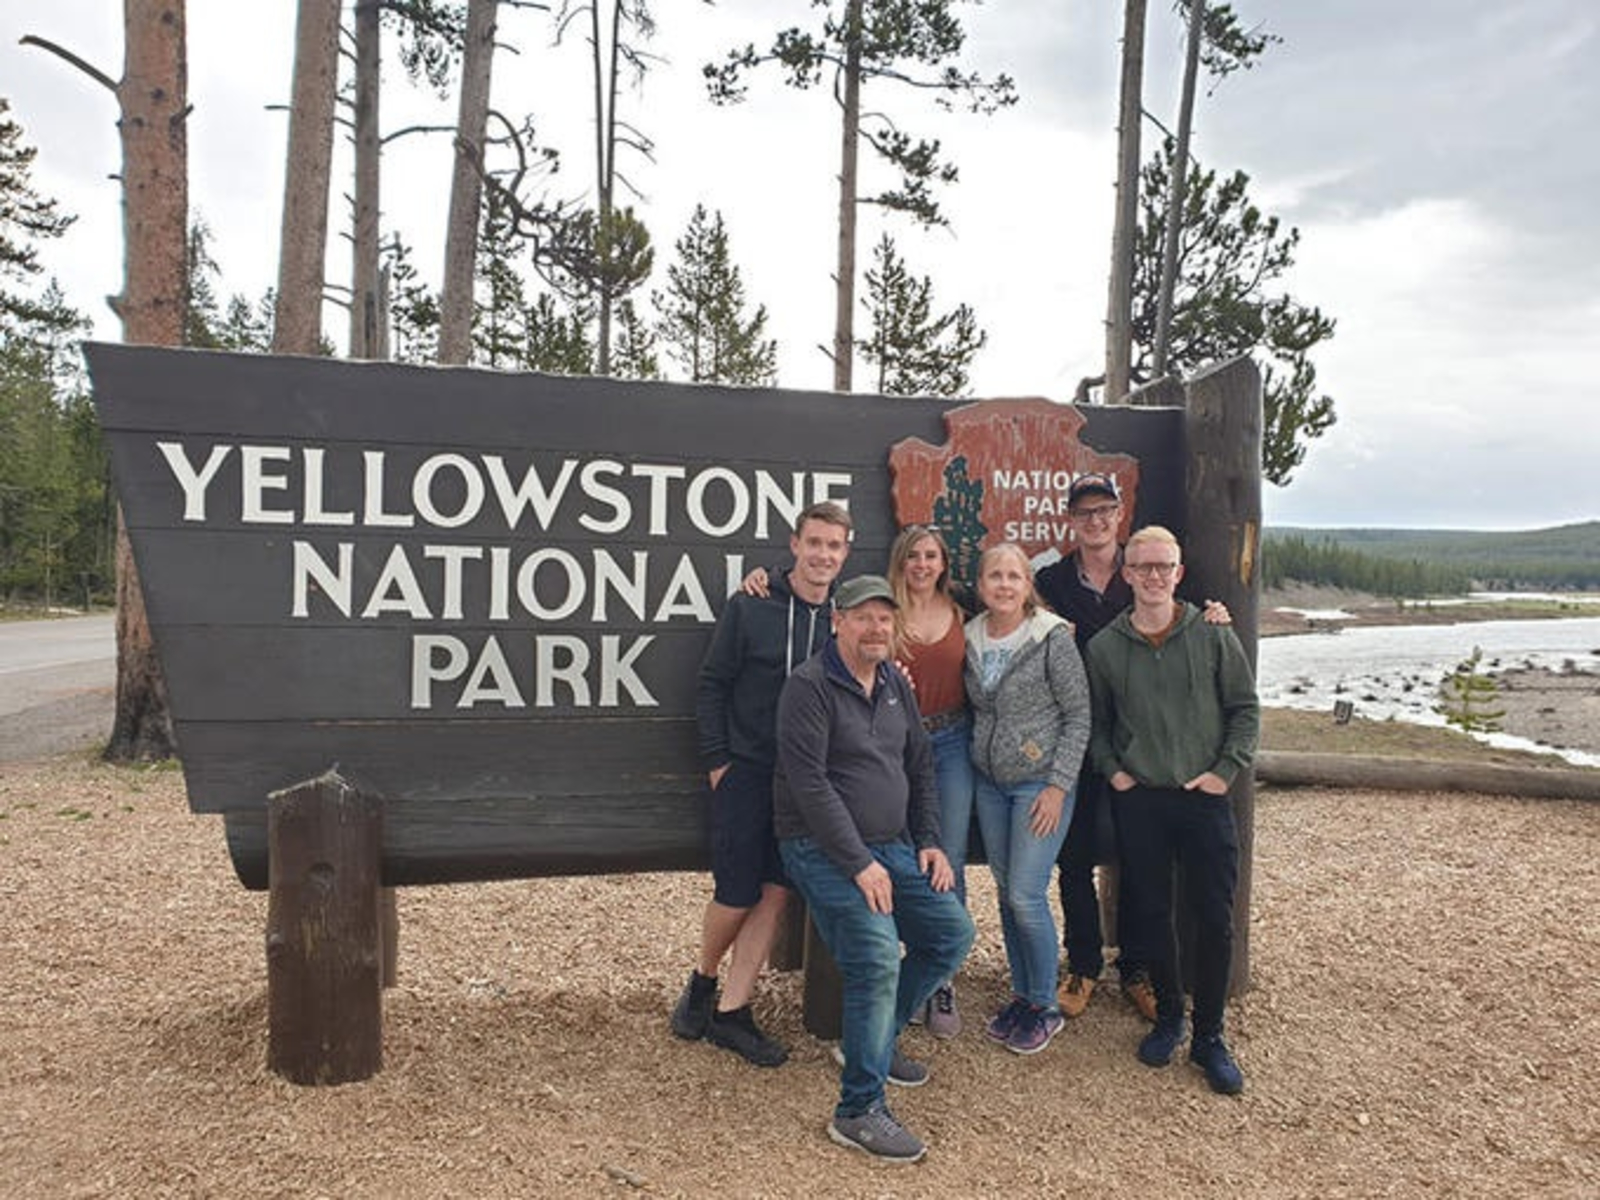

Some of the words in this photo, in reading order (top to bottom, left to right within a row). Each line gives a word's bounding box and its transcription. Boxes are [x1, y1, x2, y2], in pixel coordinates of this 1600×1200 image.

[157, 441, 853, 542] YELLOWSTONE
[993, 470, 1122, 493] NATIOL
[1025, 496, 1069, 515] PAR
[1004, 521, 1076, 541] SERVI
[411, 634, 659, 709] PARK
